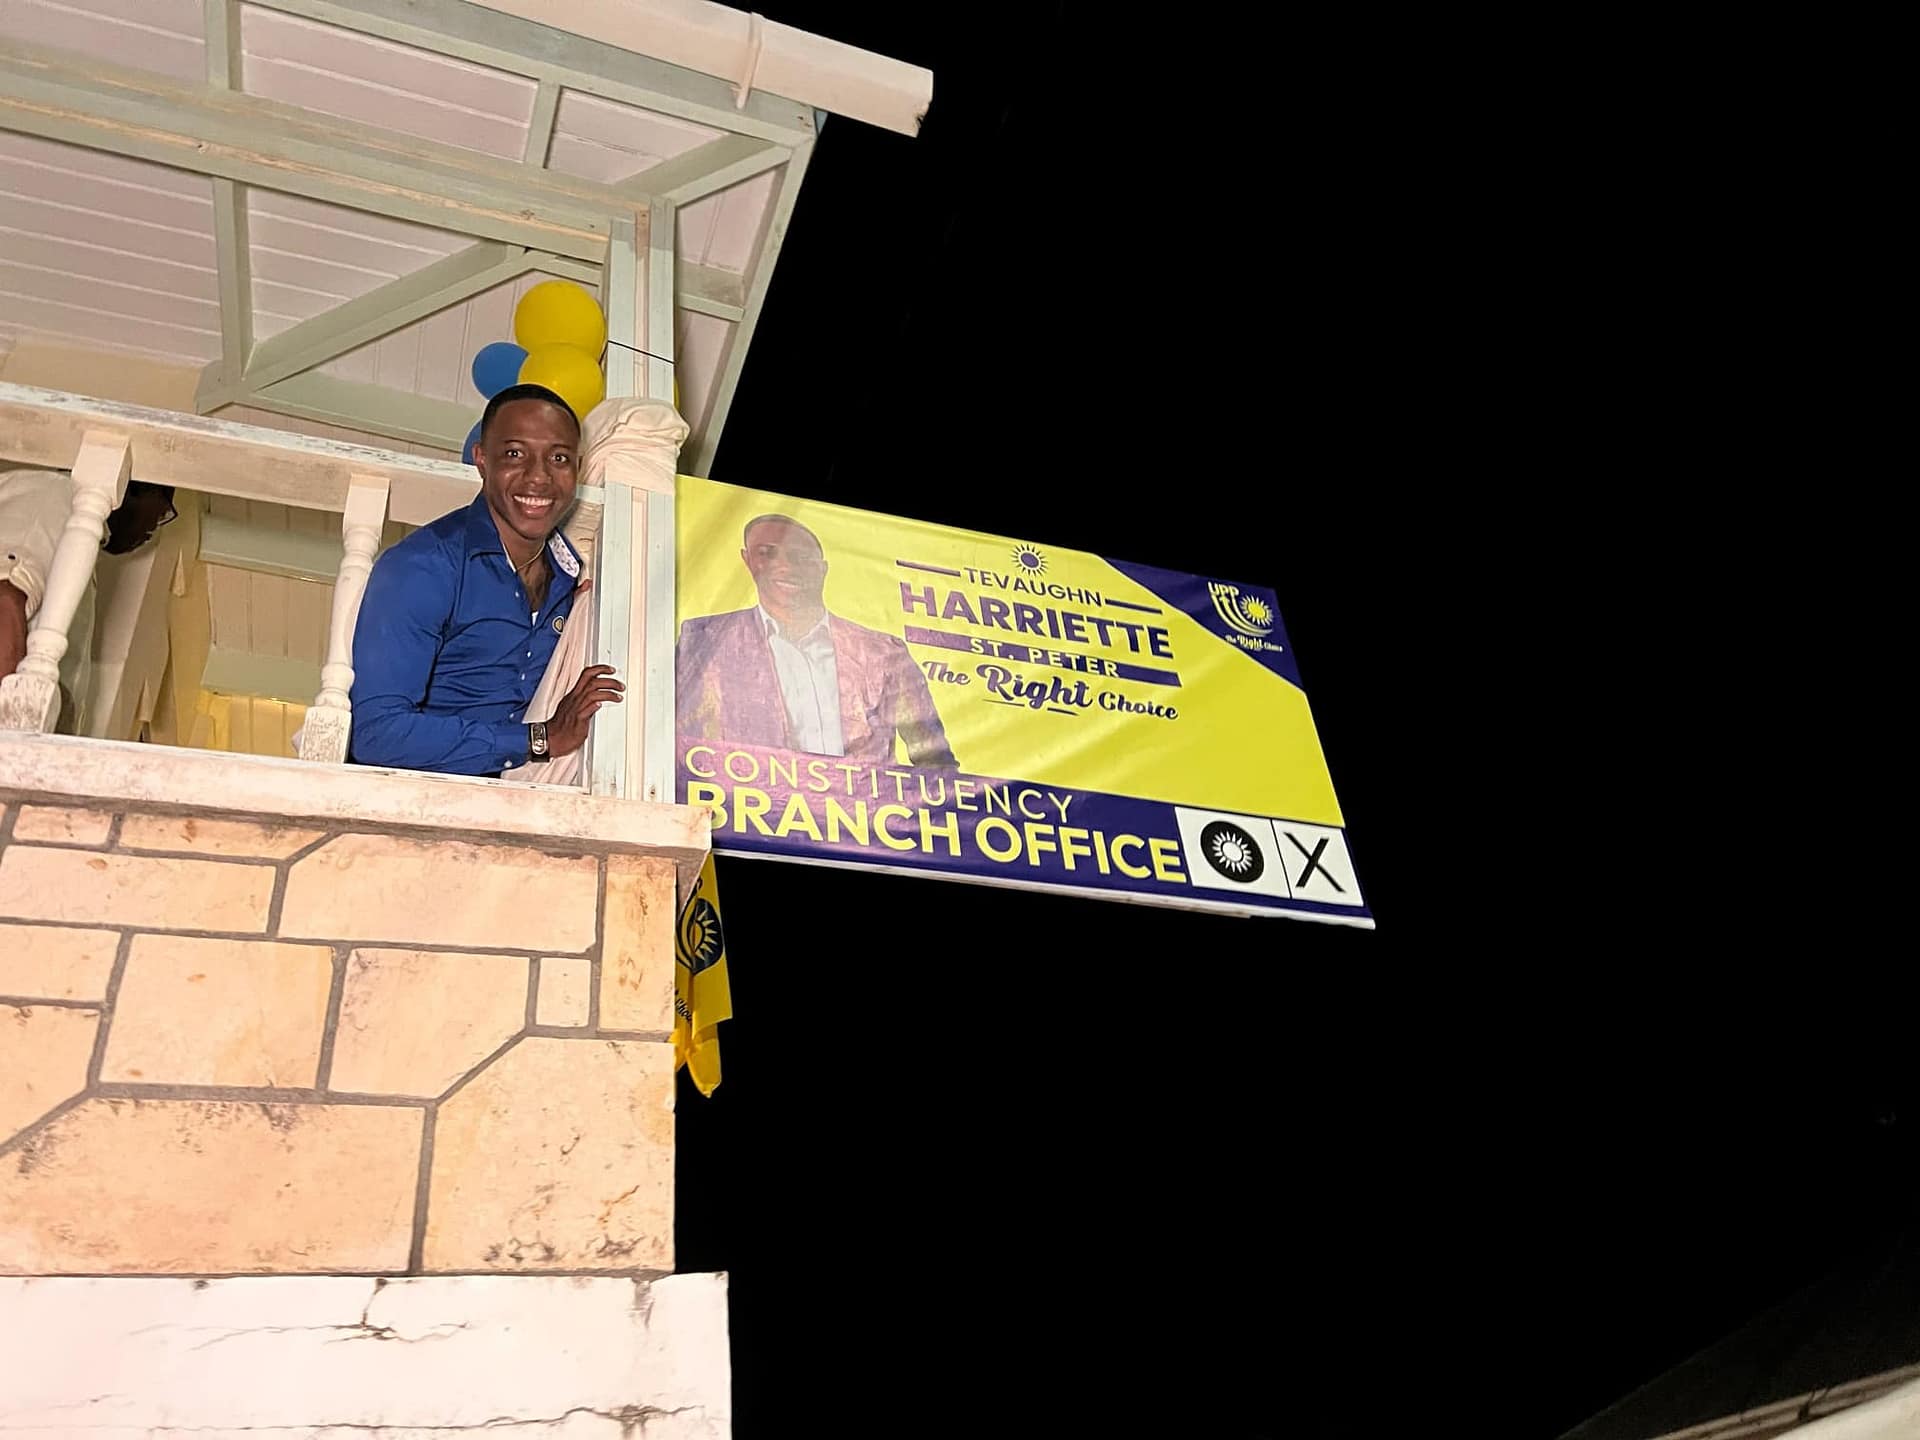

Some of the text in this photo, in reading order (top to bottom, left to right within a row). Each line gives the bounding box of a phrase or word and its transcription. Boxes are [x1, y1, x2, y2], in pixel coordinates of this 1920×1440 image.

[900, 581, 1174, 659] HARRIETTE
[964, 567, 1102, 607] TEVAUGHN
[922, 661, 1179, 720] The Right Choice
[970, 638, 1120, 678] ST. PETER
[685, 746, 1073, 823] CONSTITUENCY
[687, 780, 1188, 884] BRANCH OFFICE
